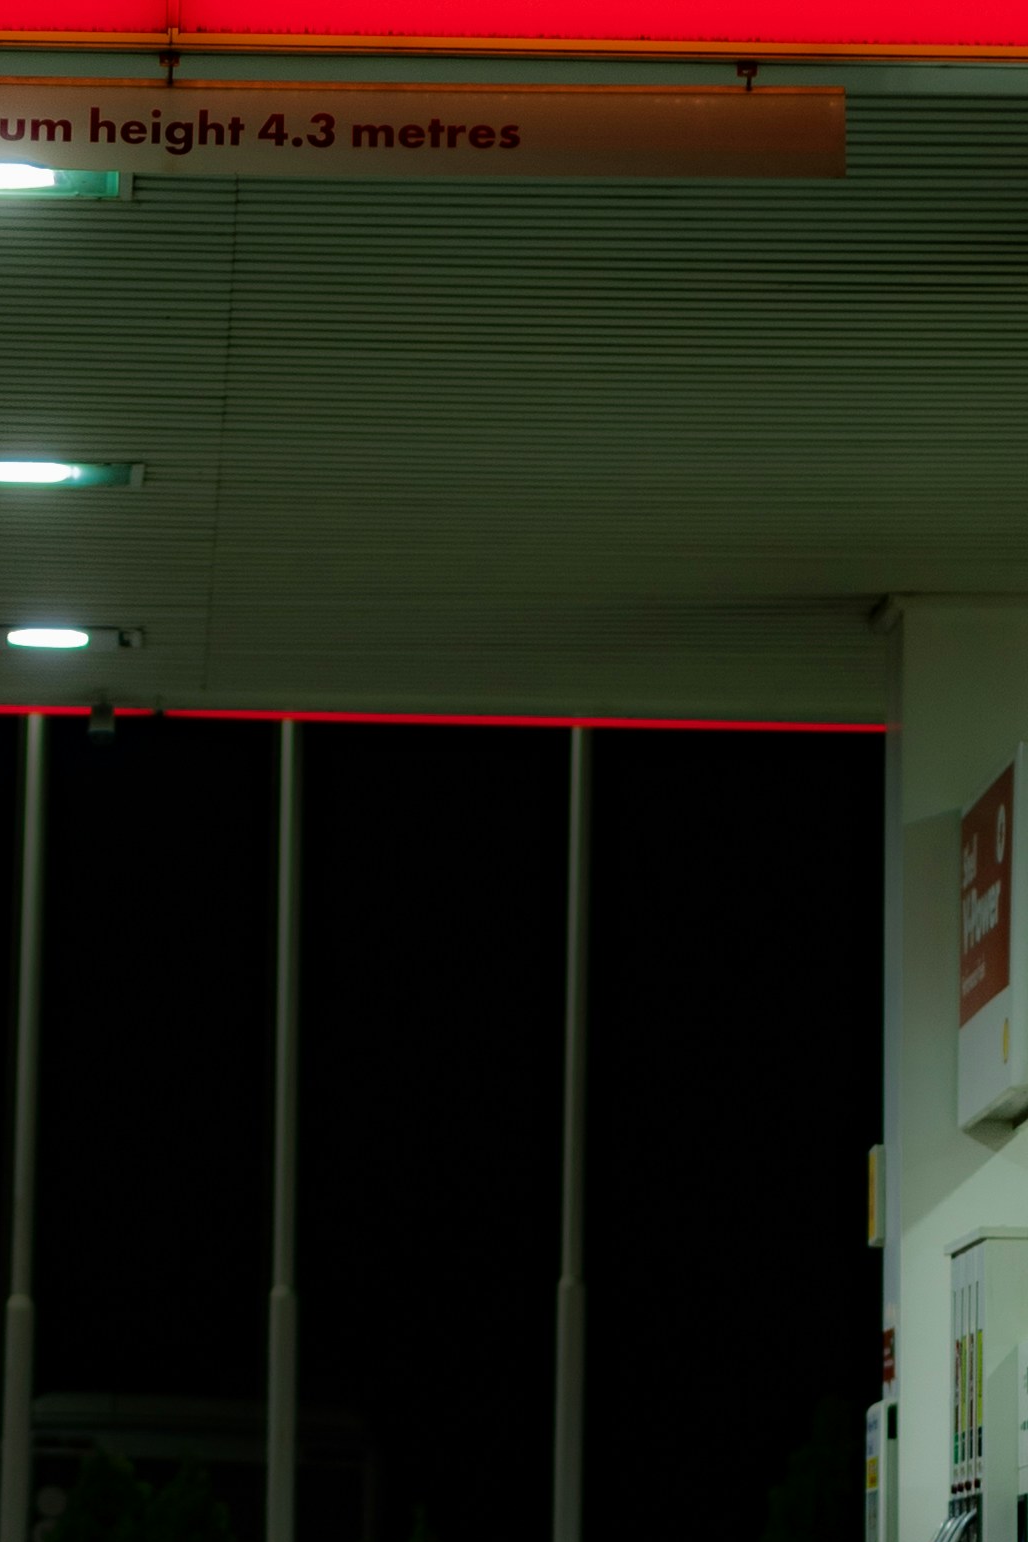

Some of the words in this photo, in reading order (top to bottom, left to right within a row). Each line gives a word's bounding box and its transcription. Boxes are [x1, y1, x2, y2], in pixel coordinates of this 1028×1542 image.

[90, 107, 245, 155] height
[258, 112, 336, 149] 4.3
[352, 118, 521, 149] metres
